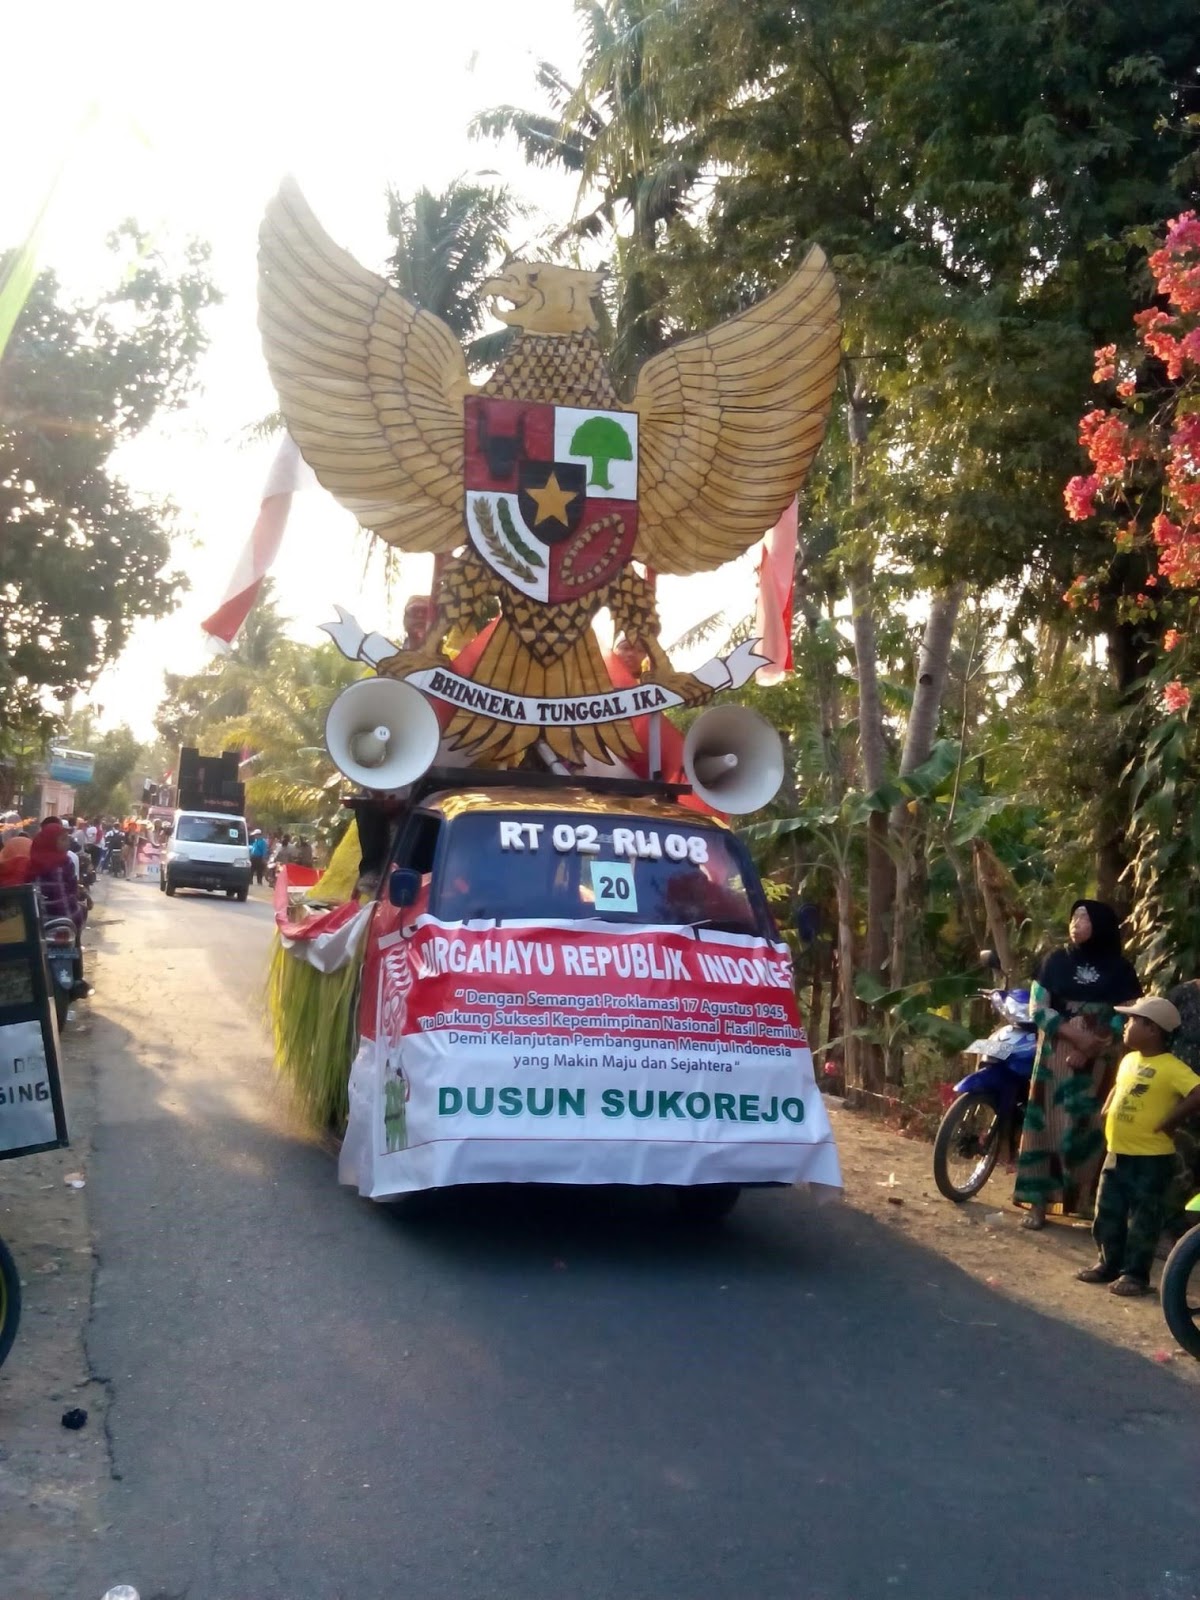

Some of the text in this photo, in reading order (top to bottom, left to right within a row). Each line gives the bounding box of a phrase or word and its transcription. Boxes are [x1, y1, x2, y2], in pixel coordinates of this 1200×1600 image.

[429, 671, 667, 722] BHINNEKA TUNGGAL IKA
[500, 821, 709, 864] RT 02 RW 08
[600, 876, 630, 900] 20
[562, 942, 692, 981] REPUBLIK
[527, 990, 600, 1010] Semangat
[602, 993, 679, 1010] Proklamasi
[681, 997, 699, 1012] 17
[701, 998, 753, 1017] Agustus
[754, 1002, 788, 1021] 1945,
[436, 1009, 491, 1029] Dukung
[494, 1010, 550, 1026] Suksesi
[552, 1012, 660, 1032] Kepemimpinan
[662, 1016, 720, 1034] Nasional
[724, 1020, 756, 1037] Hasil
[757, 1023, 799, 1040] Pemilu
[449, 1031, 792, 1057] Demi Kelanjutan Pembangunan Menuju Indonesia
[513, 1055, 549, 1070] yang
[553, 1054, 598, 1068] Makin
[602, 1055, 637, 1071] Maju
[641, 1056, 667, 1070] dan
[438, 1086, 805, 1123] DUSUN SUKOREJO
